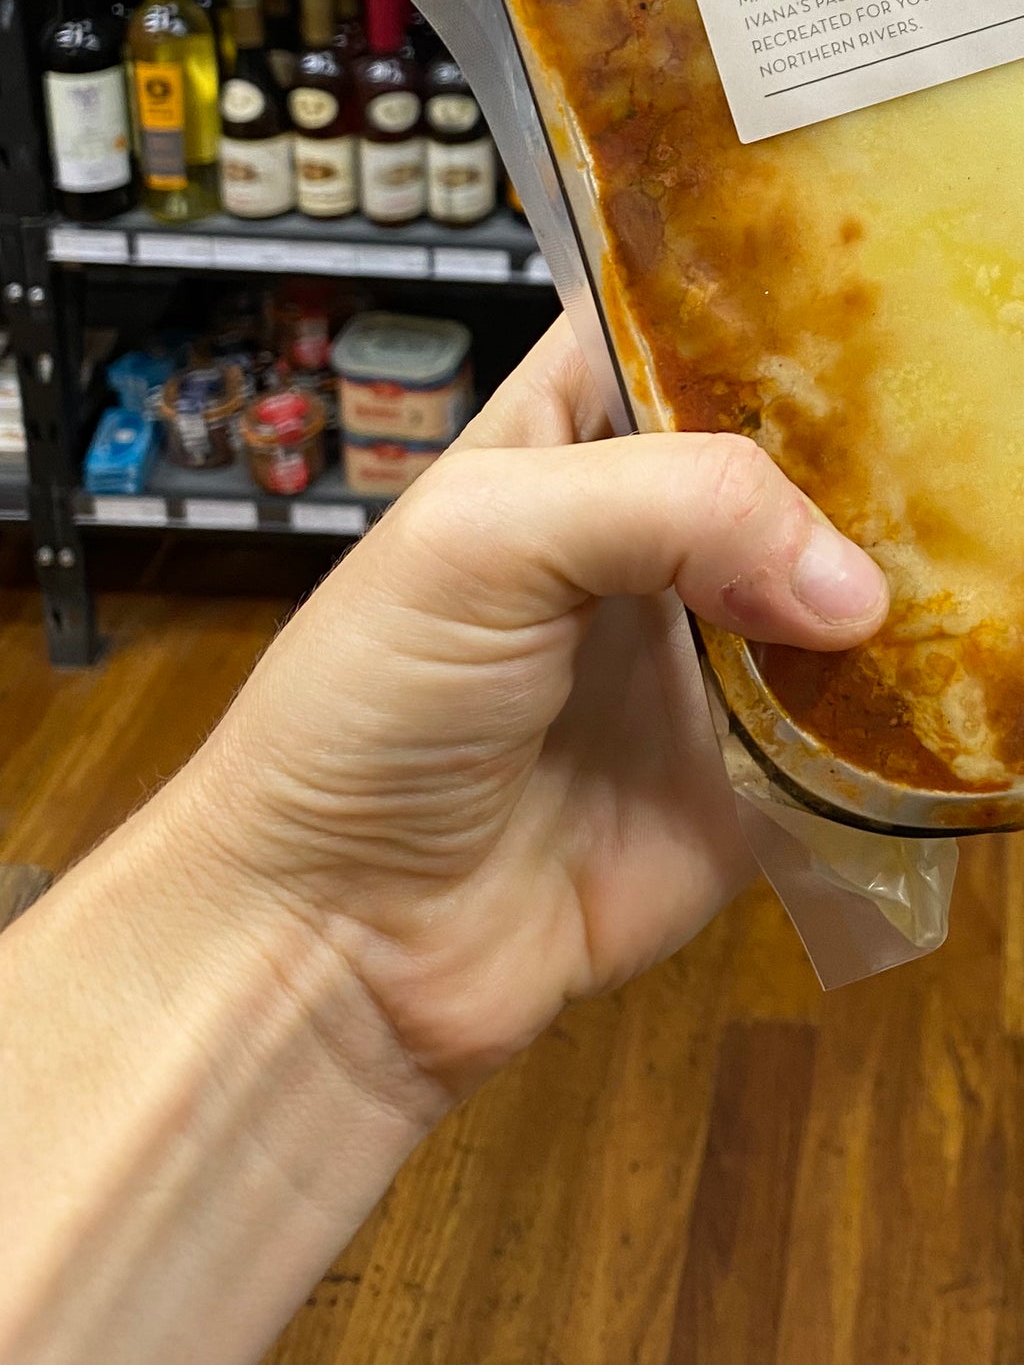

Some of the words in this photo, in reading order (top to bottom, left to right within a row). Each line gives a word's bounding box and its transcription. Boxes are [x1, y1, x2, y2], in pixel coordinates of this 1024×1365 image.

[751, 12, 851, 54] RECREATED
[855, 0, 891, 22] FOR
[758, 36, 855, 78] NORTHERN
[857, 17, 922, 47] RIVERS.
